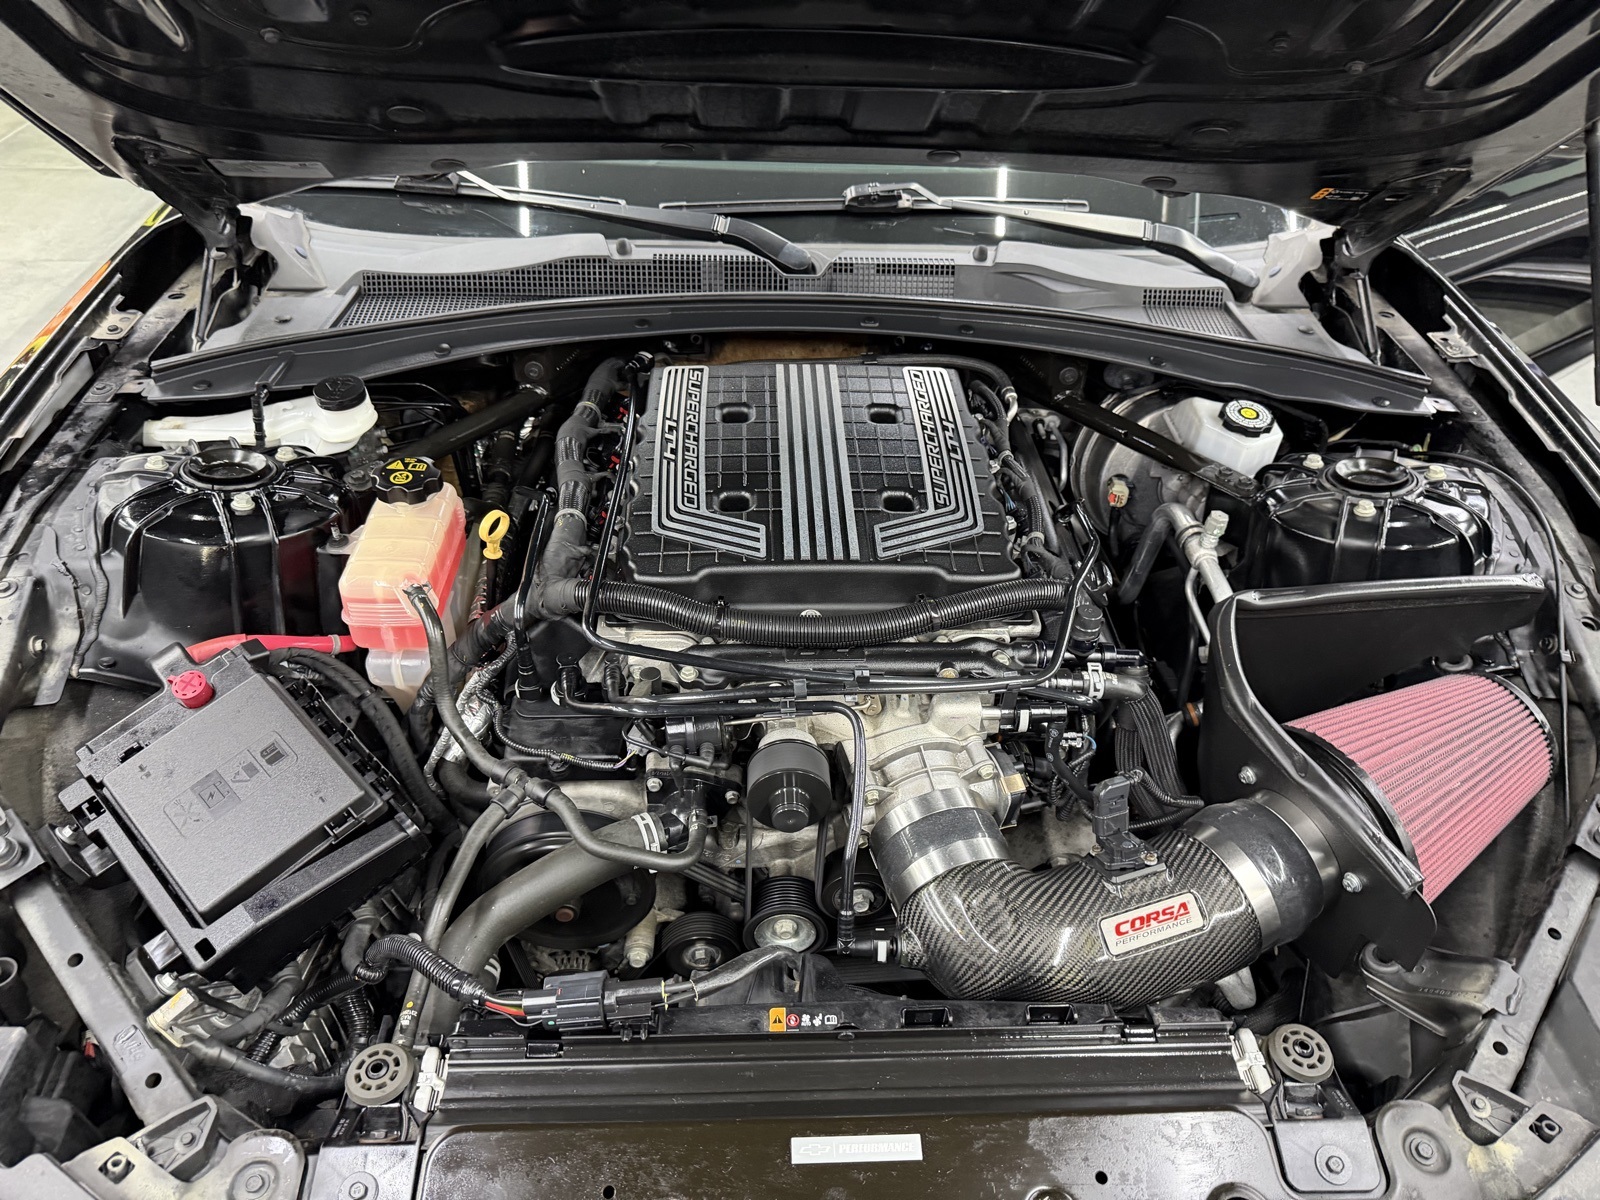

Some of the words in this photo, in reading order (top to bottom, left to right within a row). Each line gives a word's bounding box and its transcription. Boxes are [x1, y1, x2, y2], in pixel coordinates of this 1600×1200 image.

[663, 419, 678, 460] LT4
[683, 369, 702, 509] SUPERCHARGED
[909, 370, 950, 506] SUPERCHARGED
[942, 420, 963, 463] LT4
[1114, 901, 1190, 936] CORSA
[1115, 917, 1193, 946] PERFORMANCE
[839, 1142, 915, 1153] PERFORMANCE
